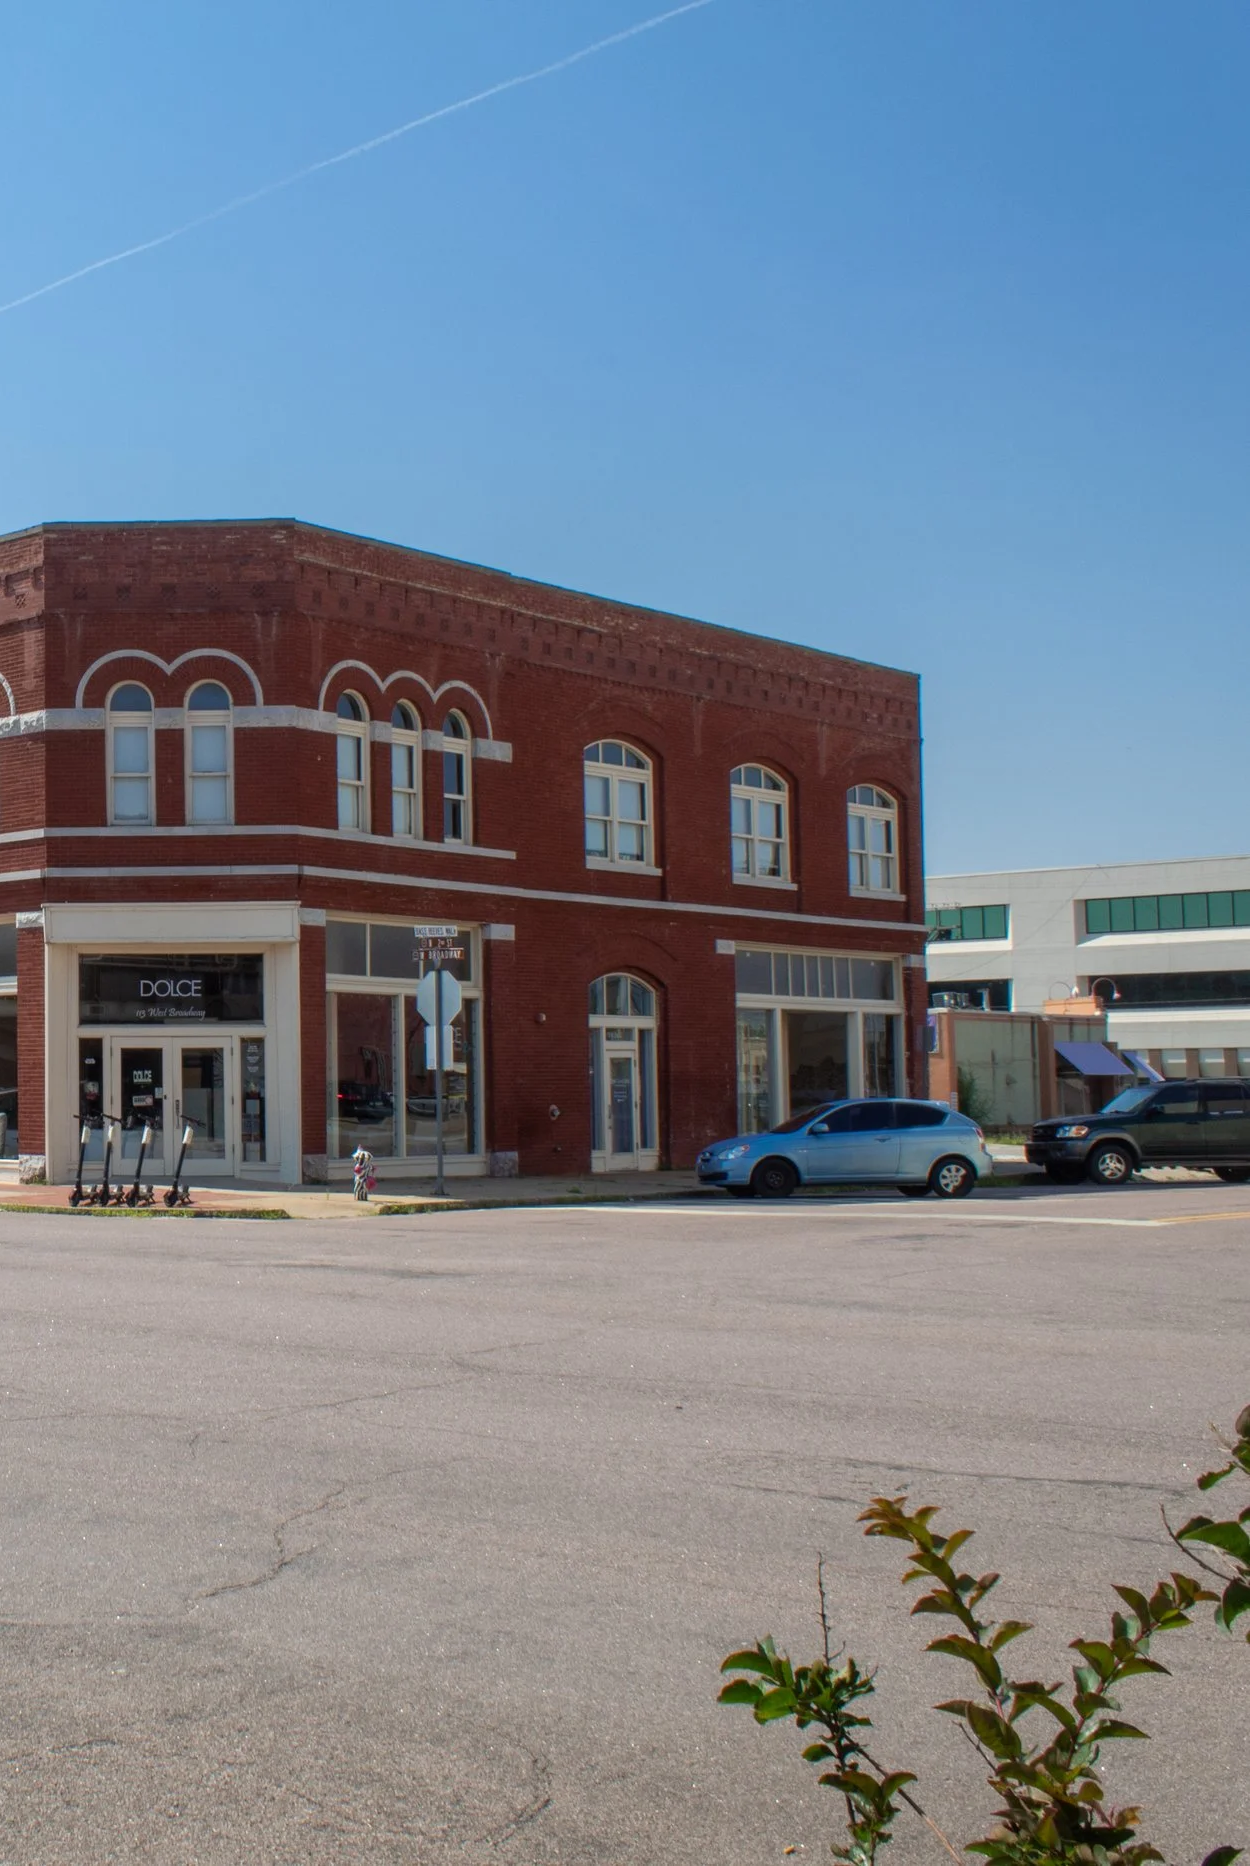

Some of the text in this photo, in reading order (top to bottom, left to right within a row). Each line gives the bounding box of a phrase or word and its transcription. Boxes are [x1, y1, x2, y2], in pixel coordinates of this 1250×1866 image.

[428, 950, 461, 960] BROADWAY
[140, 979, 202, 997] DOLCE
[168, 1006, 206, 1021] Broadway
[133, 1070, 152, 1083] DOLCE
